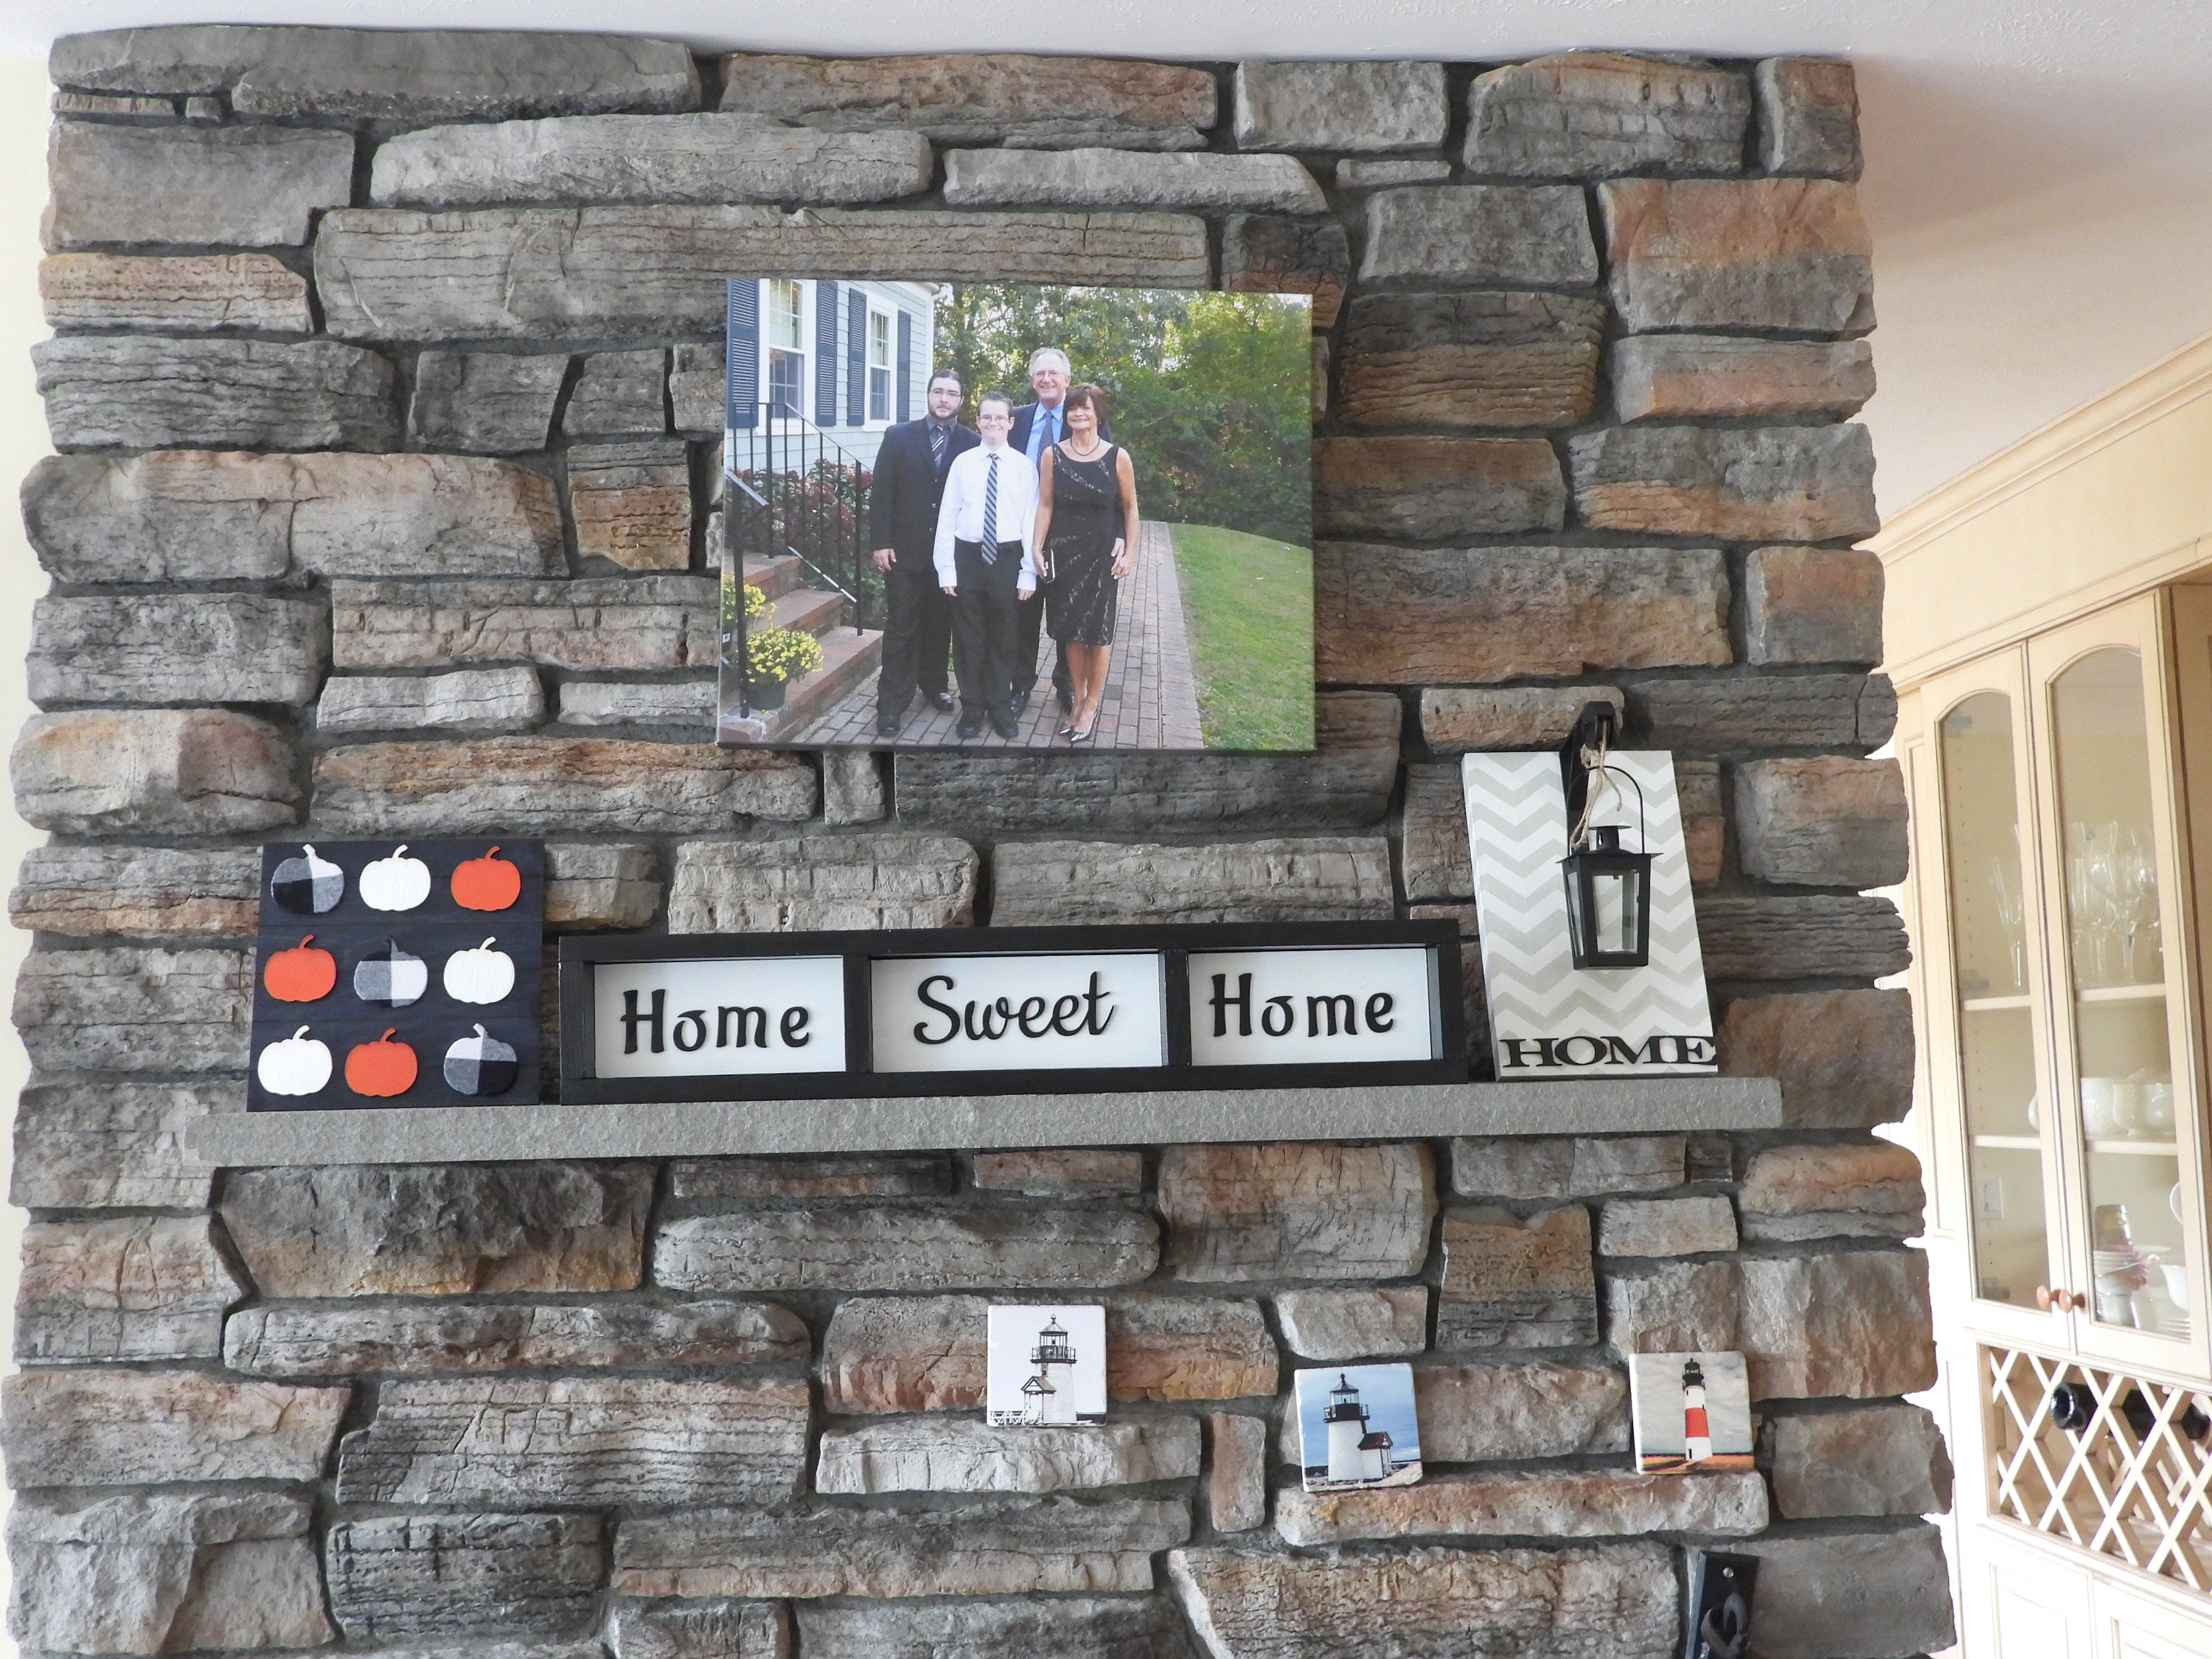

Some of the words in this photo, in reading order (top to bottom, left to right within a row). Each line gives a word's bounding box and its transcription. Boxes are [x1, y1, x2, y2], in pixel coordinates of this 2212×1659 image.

[620, 989, 810, 1055] Home
[913, 971, 1115, 1045] Sweet
[1209, 973, 1394, 1037] Home
[1499, 1035, 1717, 1068] HOME
